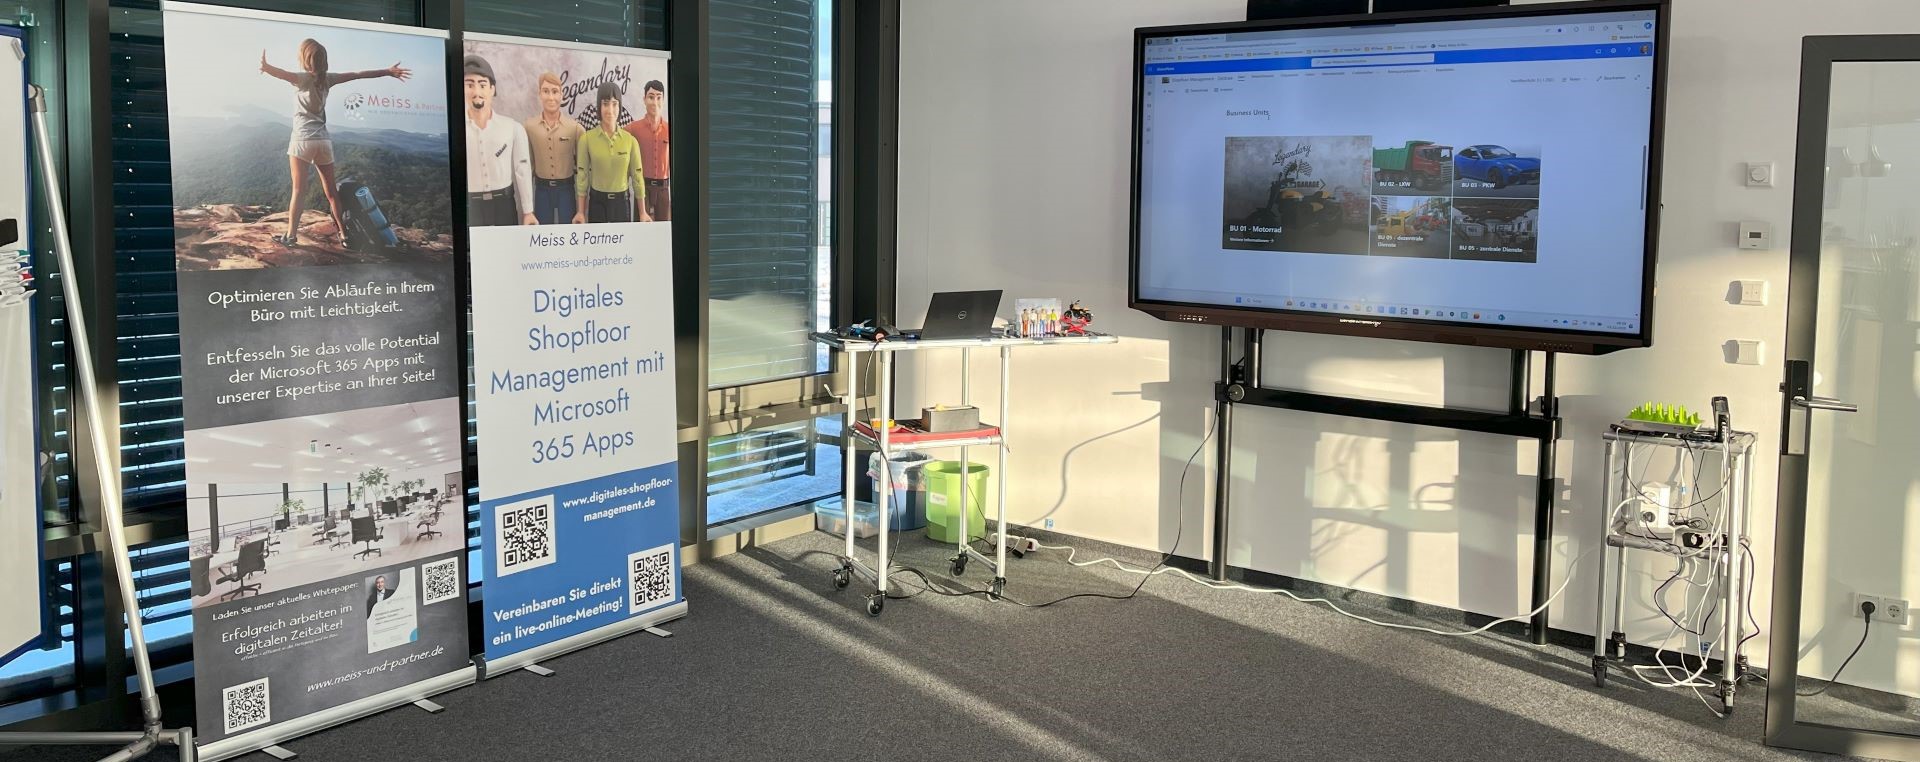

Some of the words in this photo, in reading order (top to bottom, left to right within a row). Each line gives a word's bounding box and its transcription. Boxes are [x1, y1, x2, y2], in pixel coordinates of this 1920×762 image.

[368, 95, 411, 109] Meiss
[530, 233, 564, 248] Meiss
[569, 232, 578, 246] &
[583, 231, 624, 245] Partner
[522, 254, 632, 271] www.meiss-und-partner.de
[208, 289, 295, 308] Optimieren
[300, 287, 318, 299] Sie
[325, 282, 382, 297] Abläufe
[386, 284, 397, 295] in
[400, 281, 435, 294] Ihrem
[534, 283, 623, 317] Digitales
[251, 309, 284, 322] Büro
[290, 306, 316, 319] mit
[321, 301, 403, 318] Leichtigkeit.
[207, 345, 285, 365] Entfesseln
[290, 344, 310, 358] Sie
[315, 341, 340, 356] das
[345, 338, 375, 353] volle
[380, 332, 440, 350] Potential
[529, 320, 630, 353] Shopfloor
[229, 370, 254, 384] der
[260, 360, 331, 380] Microsoft
[336, 359, 357, 372] 365
[363, 357, 399, 372] Apps
[404, 352, 425, 365] mit
[491, 356, 628, 395] Management
[637, 350, 664, 375] mit
[217, 388, 270, 405] unserer
[276, 380, 342, 400] Expertise
[346, 379, 364, 390] an
[368, 374, 397, 387] Ihrer
[402, 369, 435, 384] Seite!
[534, 387, 630, 426] Microsoft
[532, 435, 574, 463] 365
[582, 431, 634, 457] Apps
[562, 478, 673, 509] www.digitales-shopfloor-
[584, 497, 656, 522] management.de
[212, 608, 239, 621] Laden
[241, 605, 252, 614] Sie
[254, 601, 274, 611] unser
[277, 592, 311, 606] aktuelles
[313, 582, 359, 598] Whitepaper:
[494, 595, 565, 623] Vereinbaren
[569, 588, 587, 601] Sie
[590, 577, 622, 596] direkt
[222, 618, 286, 643] Erfolgreich
[290, 606, 337, 626] arbeiten
[340, 604, 353, 616] im
[234, 634, 287, 656] digitalen
[291, 620, 344, 641] Zeitalter!
[492, 632, 512, 646] ein
[515, 597, 623, 639] live-online-Meeting!
[307, 645, 444, 693] www.meiss-und-partner.de
